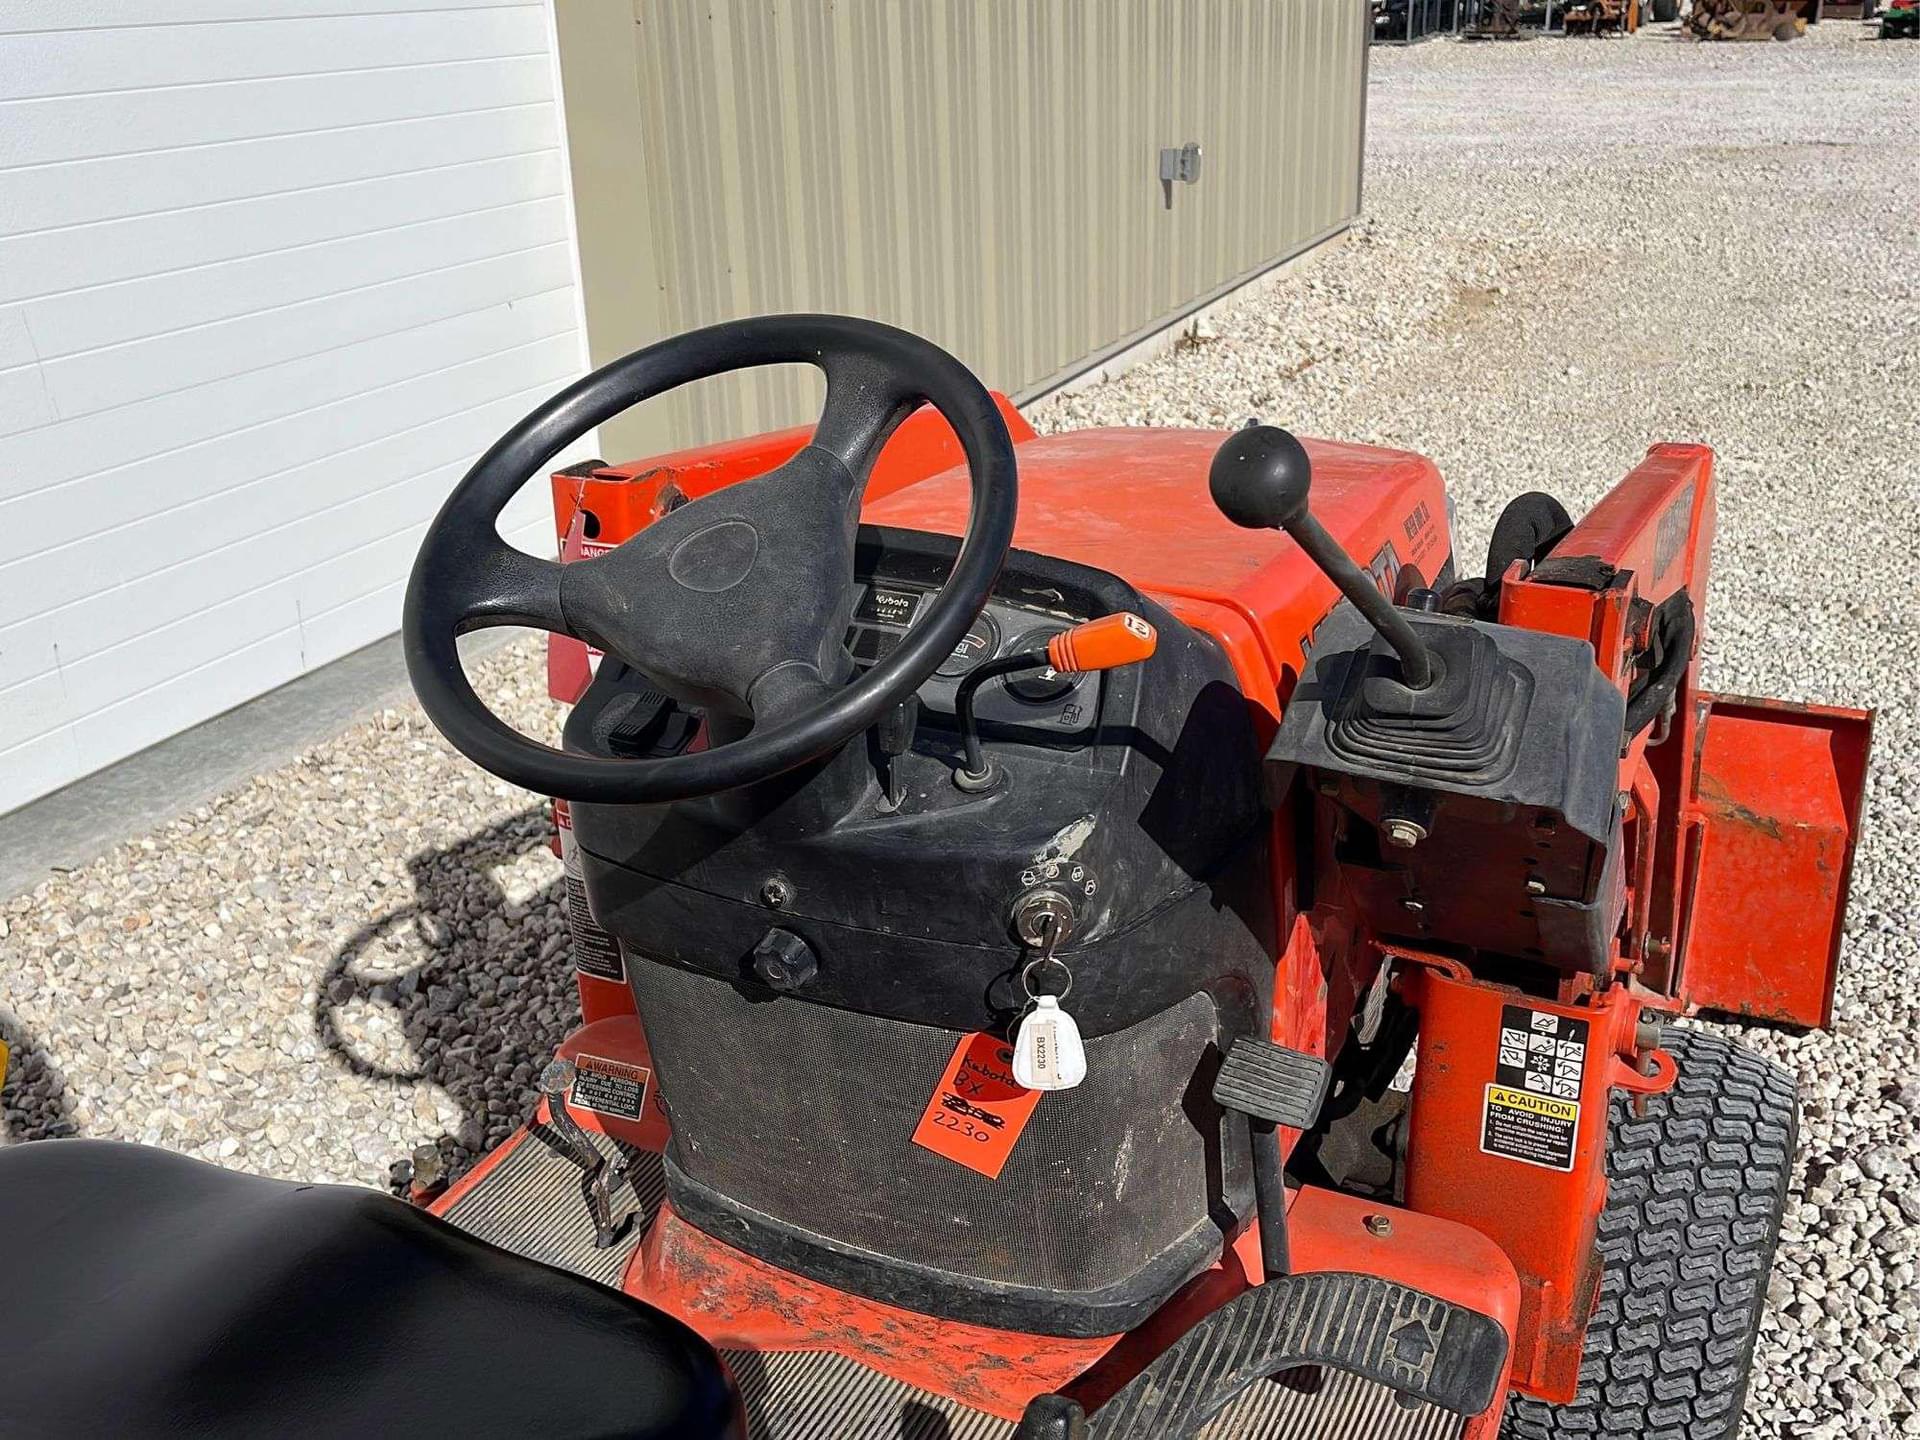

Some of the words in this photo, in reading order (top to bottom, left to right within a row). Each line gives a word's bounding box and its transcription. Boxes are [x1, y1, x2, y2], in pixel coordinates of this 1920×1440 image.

[876, 594, 909, 607] Kubota
[1036, 1036, 1046, 1070] BX2230
[593, 1061, 638, 1079] WARNING
[1508, 1094, 1570, 1116] CAUTION
[933, 1111, 990, 1142] 2230
[1490, 1111, 1514, 1121] FROM
[1516, 1118, 1564, 1133] CRUSHING:
[1508, 1109, 1534, 1119] AVOID
[1540, 1116, 1572, 1127] INJURY
